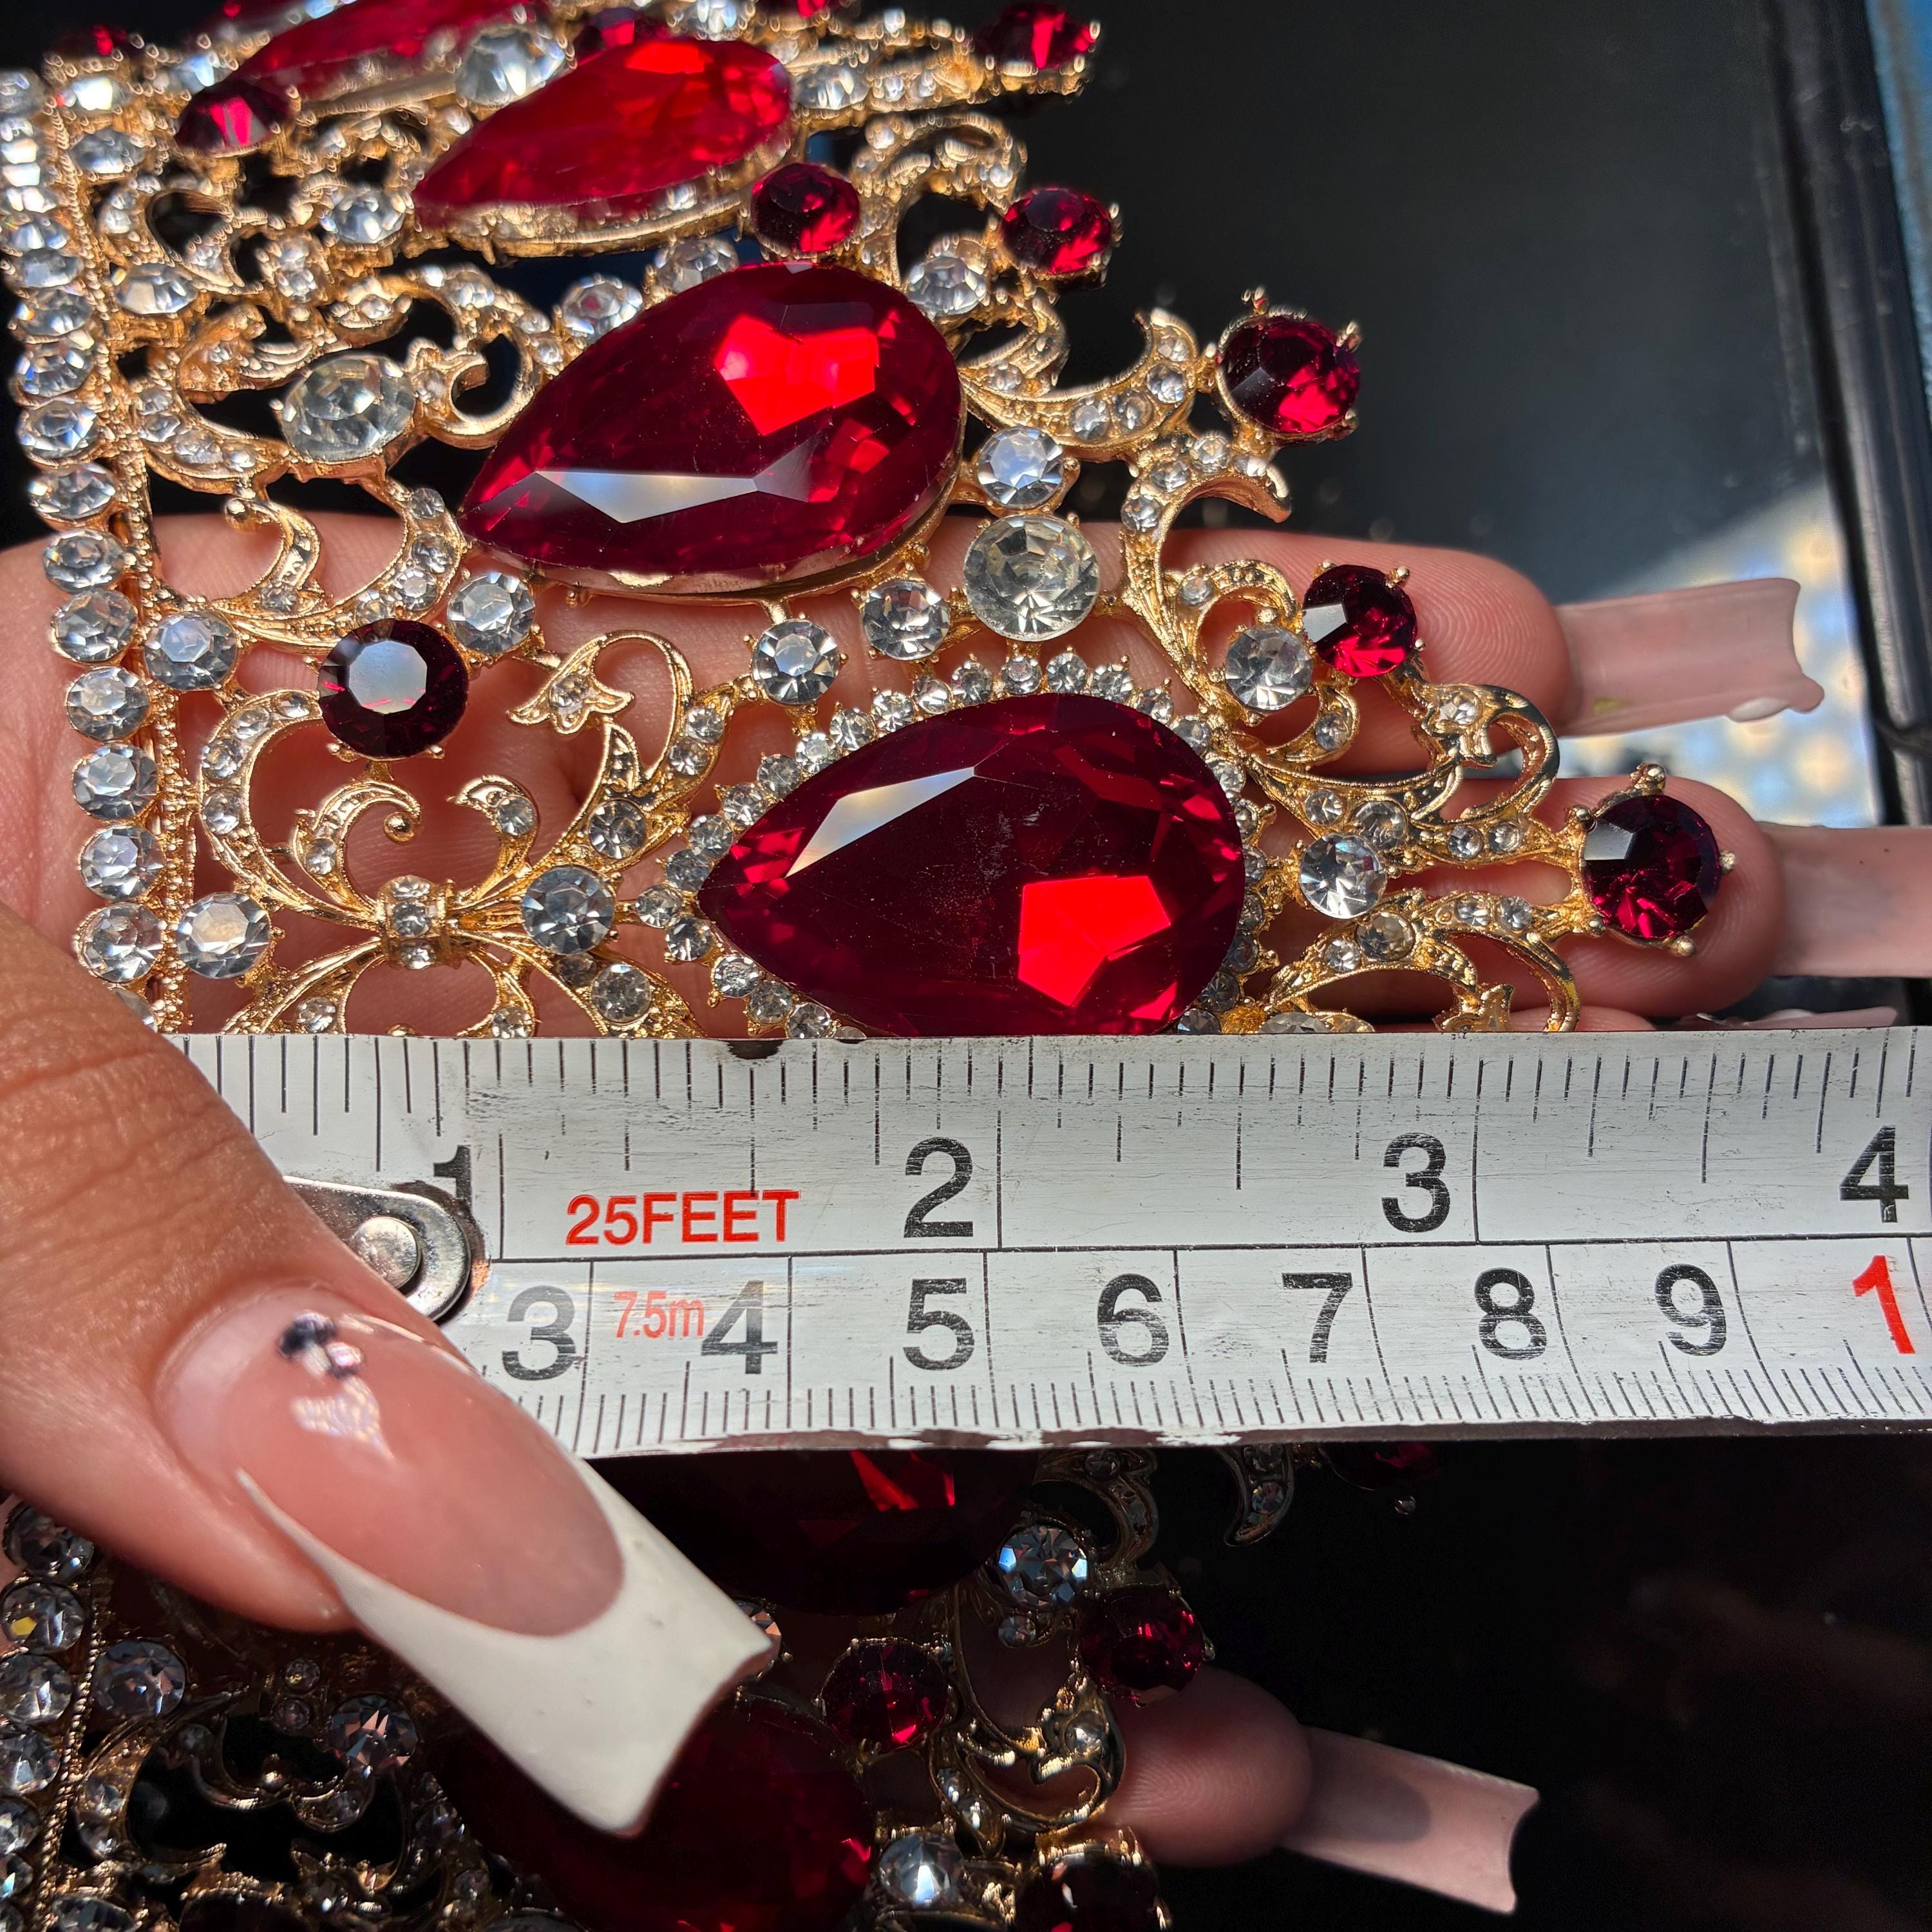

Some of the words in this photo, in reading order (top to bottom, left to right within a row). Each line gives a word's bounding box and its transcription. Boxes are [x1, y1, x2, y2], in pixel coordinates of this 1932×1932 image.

[429, 1144, 472, 1206] 1
[565, 1188, 801, 1246] 25FEET
[904, 1137, 974, 1238] 2
[1380, 1133, 1451, 1233] 3
[1839, 1124, 1909, 1223] 4
[502, 1285, 577, 1381] 3
[614, 1291, 705, 1339] 7.5m
[700, 1280, 778, 1374] 4
[903, 1278, 975, 1370] 5
[1097, 1273, 1169, 1367] 6
[1282, 1273, 1353, 1363] 7
[1474, 1267, 1547, 1360] 8
[1654, 1264, 1727, 1356] 9
[1852, 1255, 1915, 1354] 1
